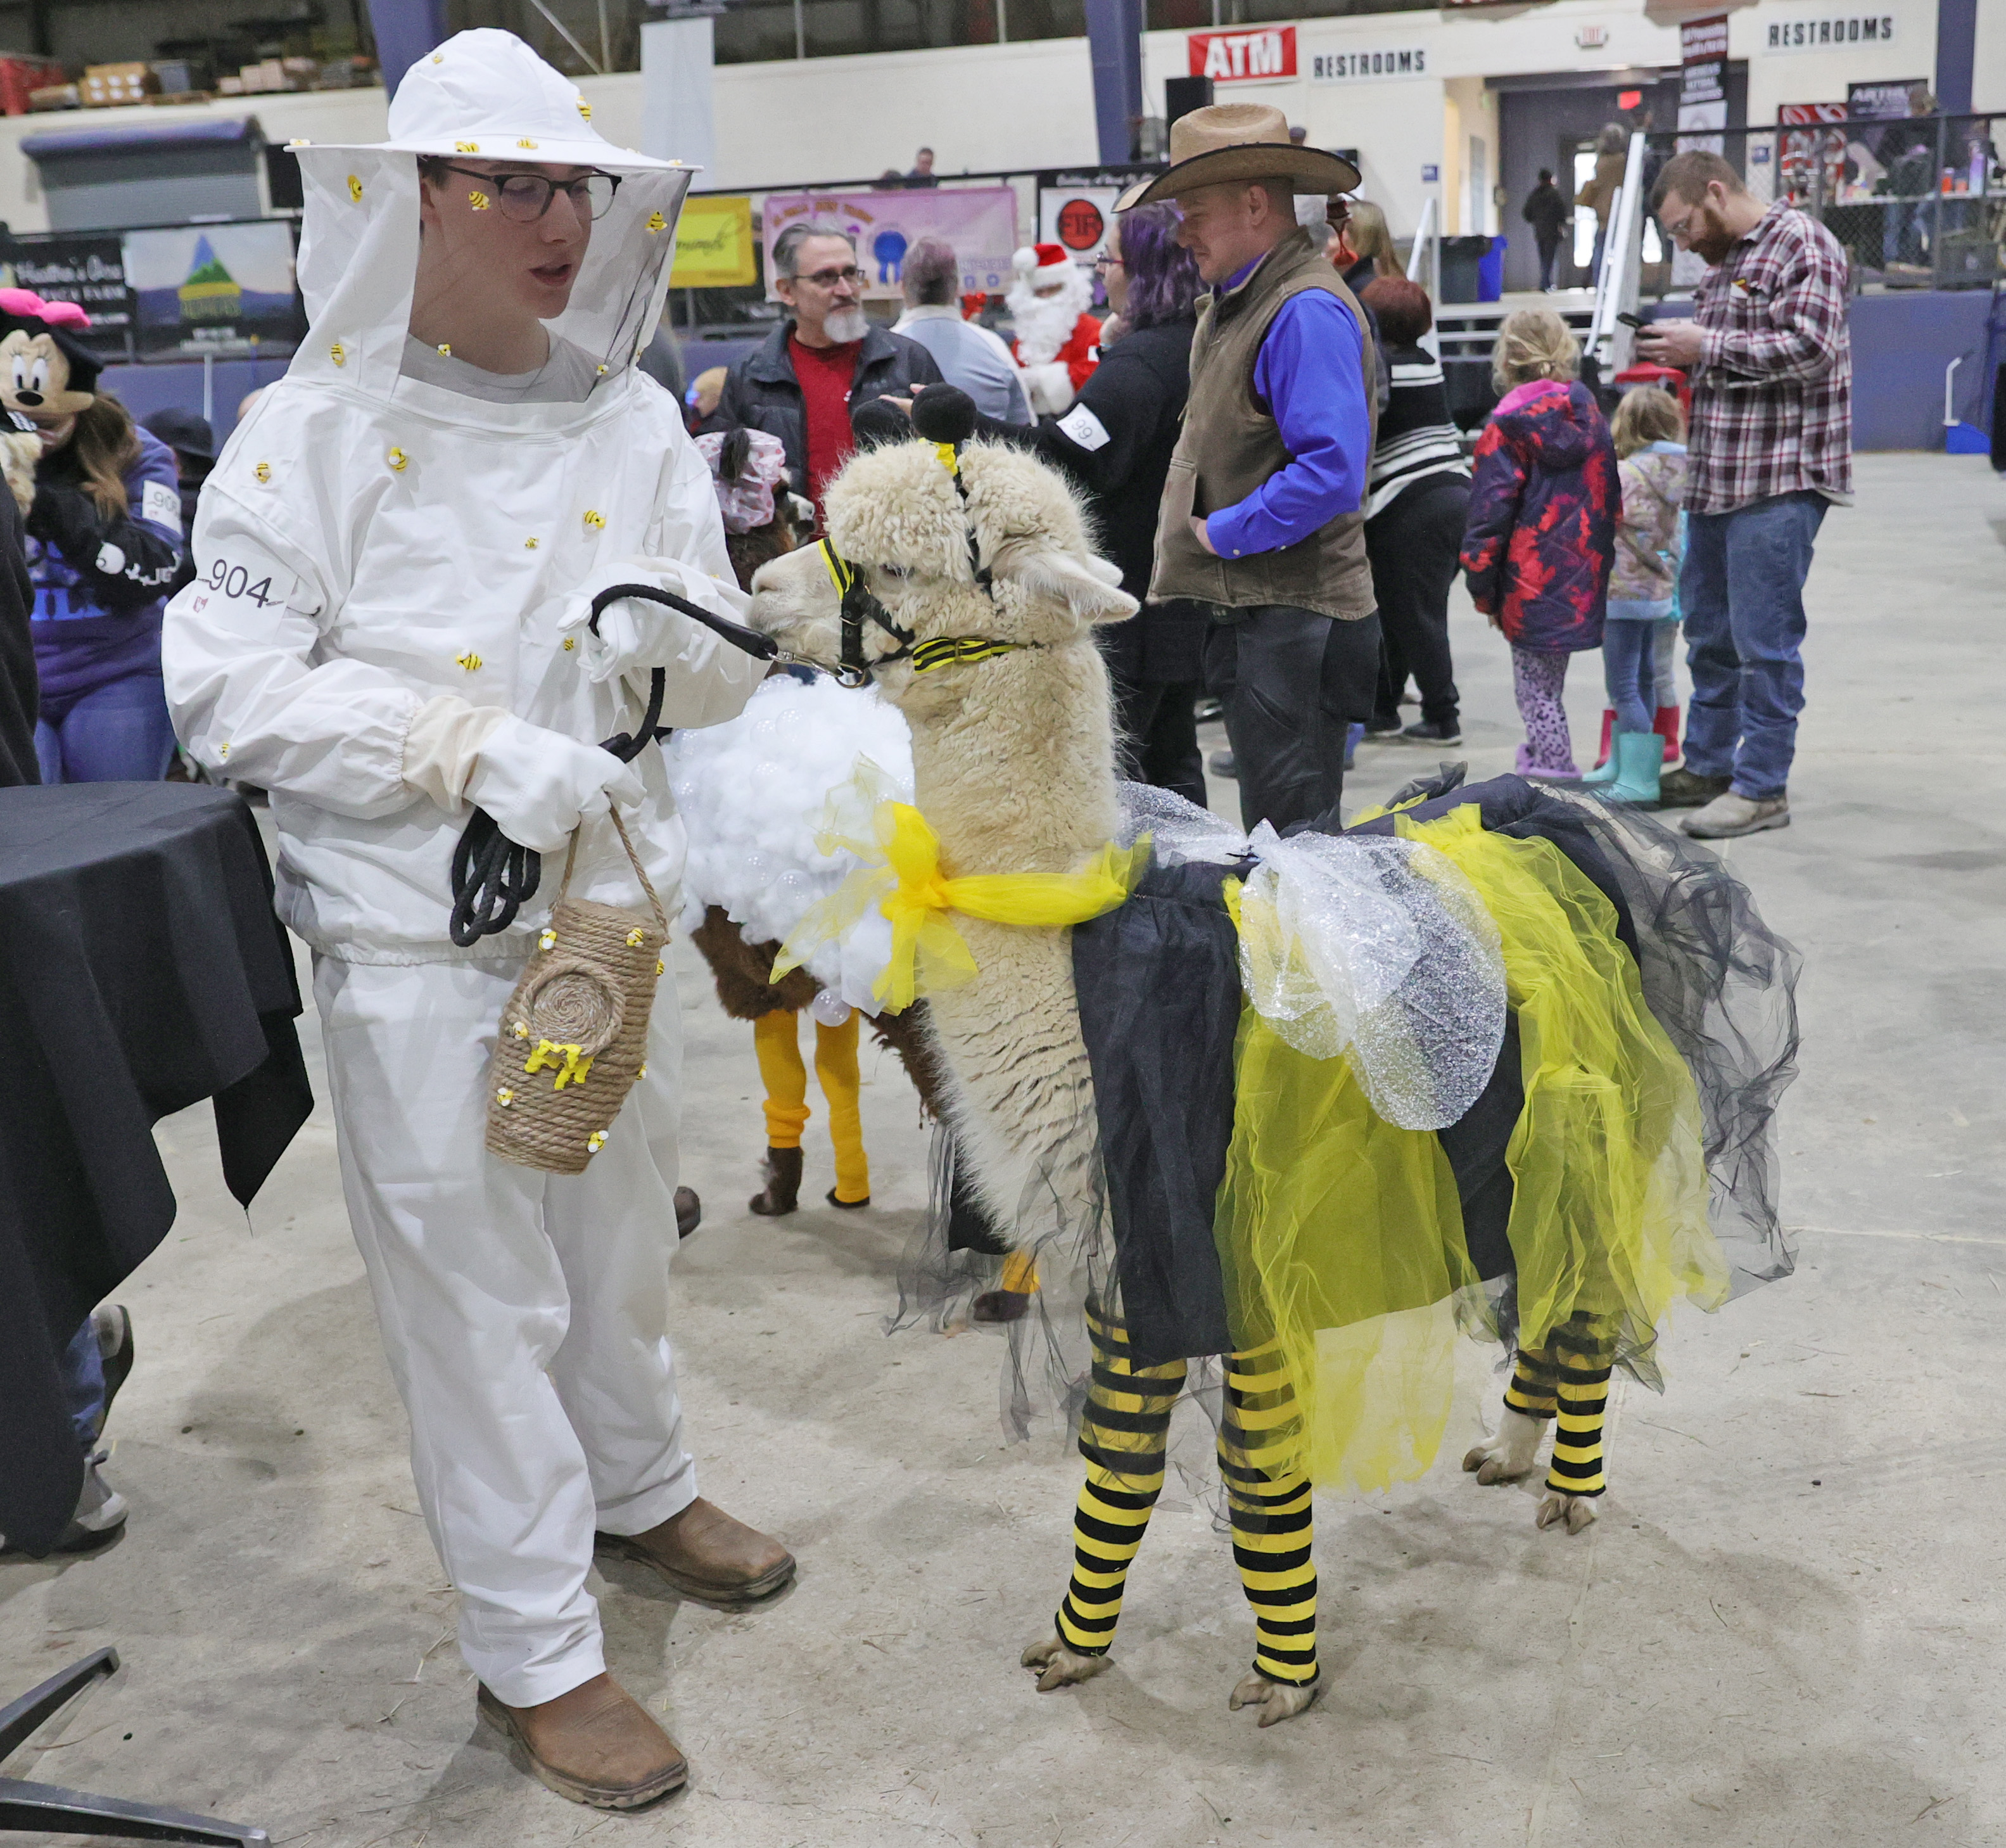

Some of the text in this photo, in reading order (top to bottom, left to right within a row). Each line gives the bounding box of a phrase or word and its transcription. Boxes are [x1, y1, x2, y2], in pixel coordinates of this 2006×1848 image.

[1769, 16, 1893, 47] RESTROOMS
[1204, 31, 1283, 79] ATM
[1314, 50, 1425, 79] RESTROOMS
[209, 558, 272, 609] 904
